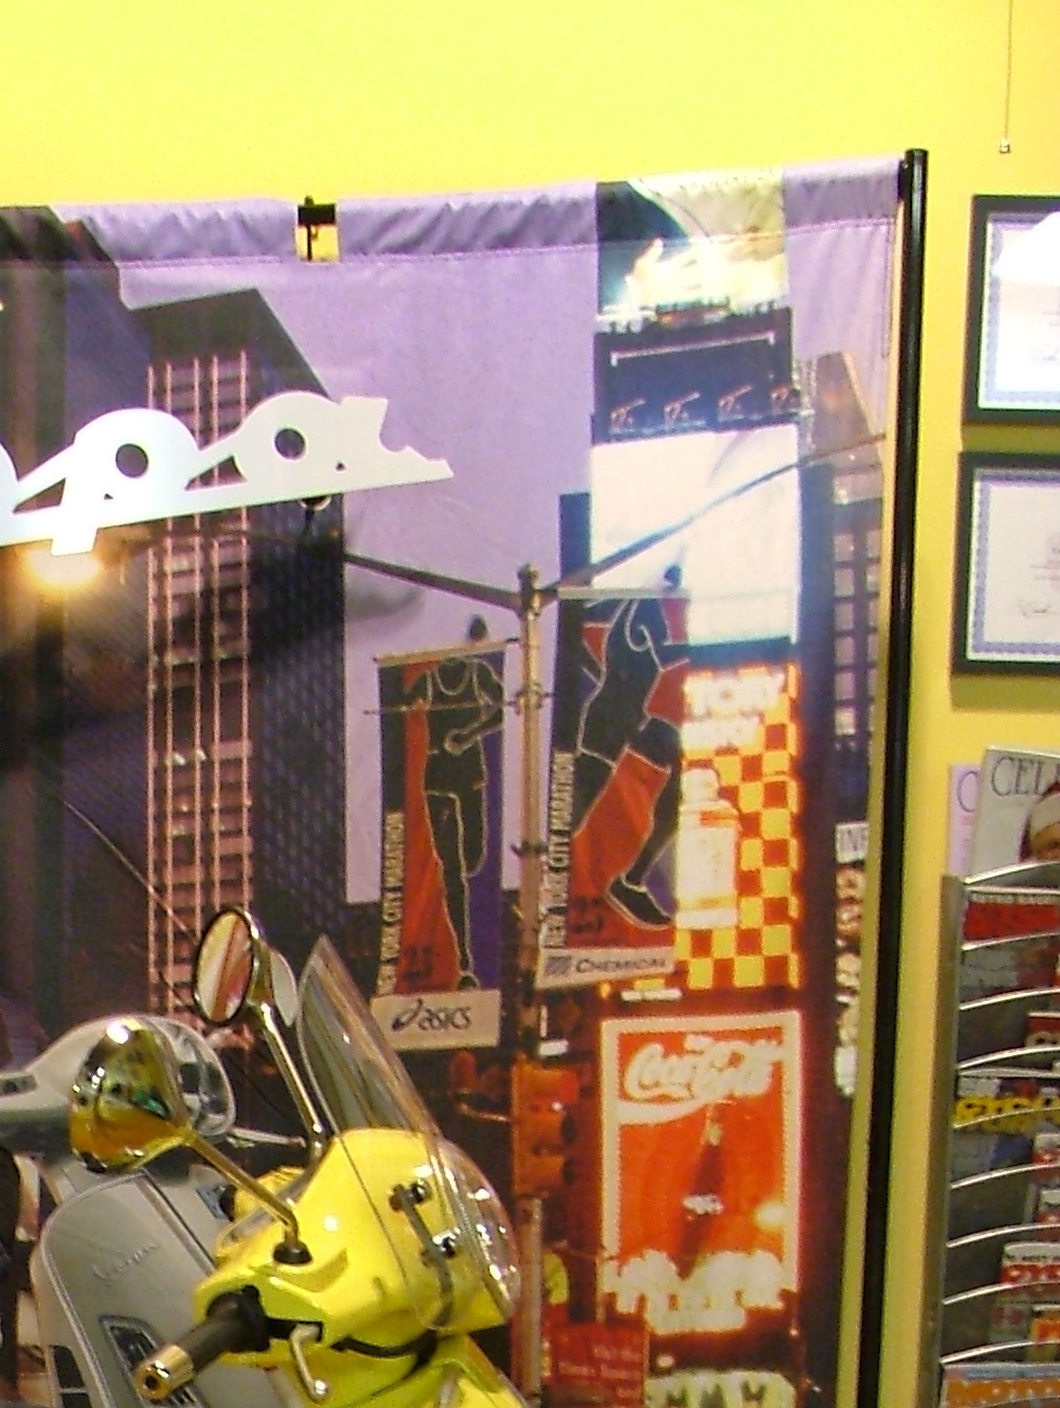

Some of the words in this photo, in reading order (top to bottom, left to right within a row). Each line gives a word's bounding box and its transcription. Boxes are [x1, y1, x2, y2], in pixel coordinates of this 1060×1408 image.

[550, 753, 575, 831] MARATHON
[382, 812, 405, 889] MARATHON
[547, 834, 570, 868] CITY
[381, 891, 403, 924] CITY
